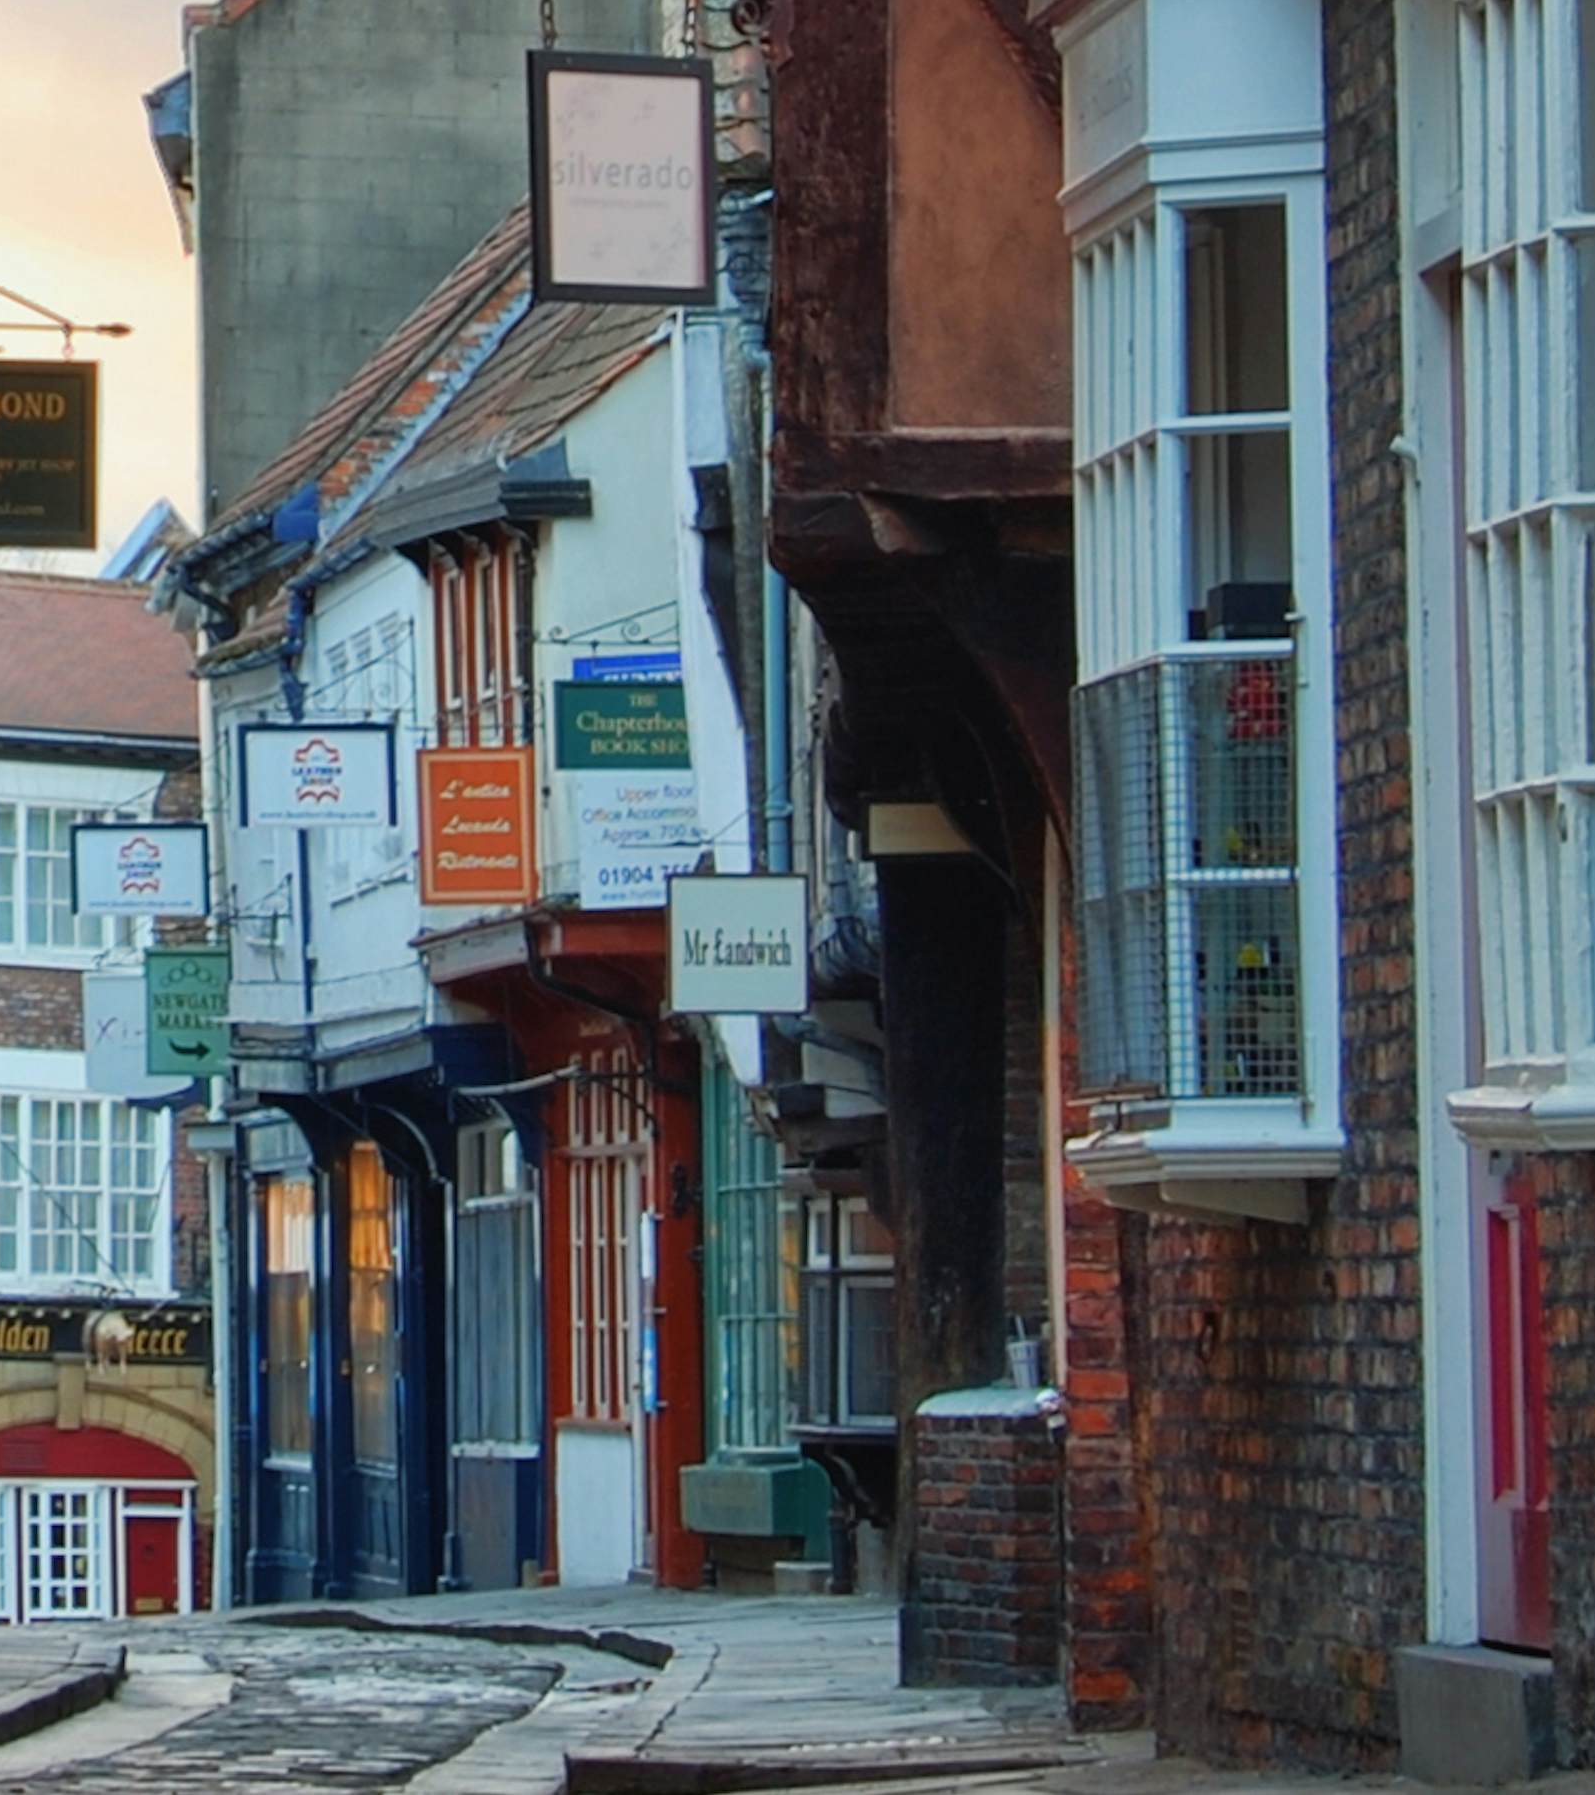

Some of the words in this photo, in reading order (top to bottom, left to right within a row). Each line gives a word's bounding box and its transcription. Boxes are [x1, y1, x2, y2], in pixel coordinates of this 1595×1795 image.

[552, 154, 695, 191] silverado
[650, 738, 690, 755] SHO
[598, 866, 653, 886] 01904
[683, 928, 708, 966] Mr
[127, 1323, 188, 1355] leece
